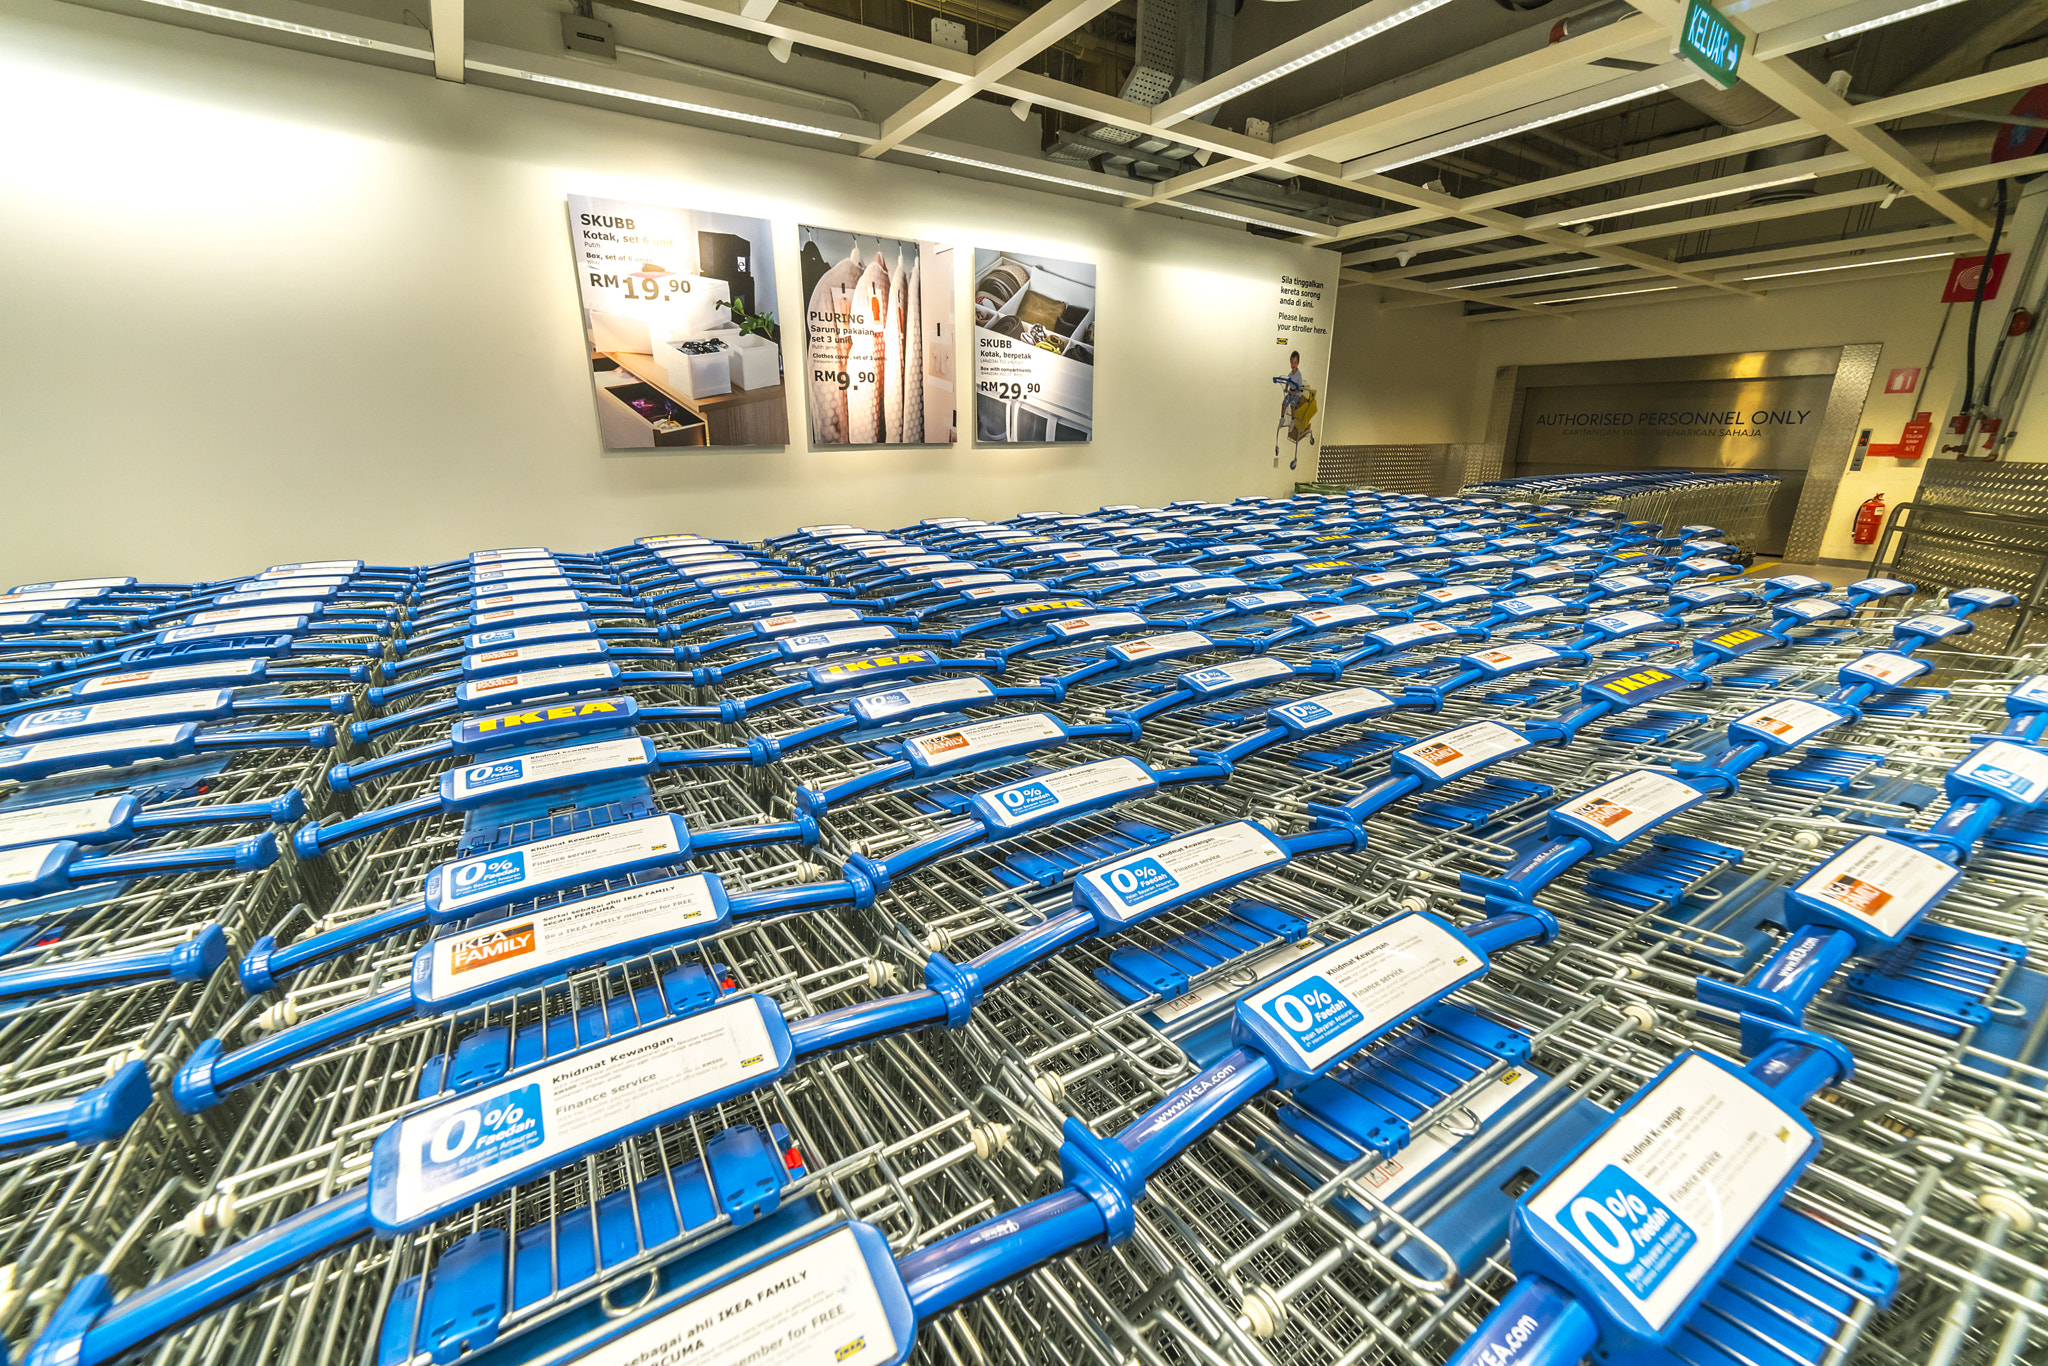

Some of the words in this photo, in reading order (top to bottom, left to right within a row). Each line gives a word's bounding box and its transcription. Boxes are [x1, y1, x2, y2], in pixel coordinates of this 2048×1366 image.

[1688, 4, 1729, 67] KELUAR
[580, 214, 635, 230] SKUBB
[583, 230, 620, 244] Kotak,
[623, 235, 640, 244] set
[643, 236, 650, 245] 6
[653, 237, 674, 247] unit
[586, 252, 603, 260] Box,
[1281, 276, 1292, 284] Sila
[1294, 277, 1324, 289] tinggalkan
[1280, 286, 1300, 296] kereta
[1301, 290, 1320, 300] sorong
[1280, 298, 1294, 306] anda
[1302, 300, 1314, 308] sini.
[810, 311, 864, 324] PLURING
[1278, 312, 1298, 322] Please
[1298, 314, 1314, 324] leave
[810, 324, 840, 335] Sarung
[843, 327, 877, 336] pakaian,
[1278, 324, 1291, 332] your
[1292, 324, 1312, 333] stroller
[1314, 326, 1328, 334] here.
[835, 336, 852, 344] unit
[980, 338, 1012, 348] SKUBB
[980, 350, 1002, 358] Kotak,
[1004, 352, 1032, 360] berpetak
[1536, 412, 1634, 426] AUTHORISED
[1637, 411, 1744, 426] PERSONNEL
[1751, 410, 1812, 425] ONLY
[1718, 428, 1762, 438] SAHAJA
[1316, 534, 1352, 542] IKEA
[1304, 560, 1352, 569] IKEA
[1016, 600, 1086, 614] IKEA
[1712, 628, 1764, 648] IKEA
[827, 654, 926, 675] IKEA
[1603, 668, 1672, 695] IKEA
[479, 701, 618, 732] IKEA
[920, 736, 950, 746] IKEA
[926, 737, 964, 752] FAMILY
[1424, 748, 1457, 763] FAMILY
[470, 764, 514, 782] 0%
[1002, 788, 1042, 808] 0%
[530, 840, 566, 852] Khidmat
[568, 831, 610, 844] Kewangan
[532, 854, 565, 867] Finance
[568, 848, 598, 859] service
[1158, 846, 1184, 858] Khidmat
[1199, 854, 1221, 865] service
[456, 860, 513, 886] 0%
[483, 867, 520, 881] Faedah
[1110, 866, 1156, 894] 0%
[1140, 873, 1168, 888] Faedah
[542, 912, 569, 922] Sertai
[570, 904, 604, 916] sebagai
[622, 892, 644, 902] IKEA
[645, 886, 675, 896] FAMILY
[543, 917, 572, 927] secara
[574, 906, 616, 919] PERCUMA
[566, 924, 588, 934] IKEA
[590, 916, 622, 928] FAMILY
[624, 907, 657, 919] member
[672, 898, 692, 907] FREE
[453, 930, 508, 954] IKEA
[454, 934, 532, 967] FAMILY
[1326, 958, 1356, 977] Khidmat
[1778, 937, 1820, 978] www.IKEA.com
[1352, 981, 1380, 999] Finance
[1380, 968, 1404, 984] service
[1274, 989, 1332, 1032] 0%
[1314, 1000, 1348, 1022] Faedah
[1300, 1031, 1316, 1042] Pelan
[1314, 1020, 1336, 1034] Bayaran
[552, 1059, 606, 1084] Khidmat
[610, 1036, 674, 1063] Kewangan
[556, 1091, 608, 1116] Finance
[611, 1073, 657, 1095] service
[1154, 1064, 1236, 1124] www.IKEA.com
[430, 1102, 524, 1164] 0%
[475, 1117, 536, 1150] Faedah
[1620, 1135, 1653, 1165] Khidmat
[1570, 1188, 1648, 1266] 0%
[1630, 1206, 1670, 1248] Faedah
[688, 1316, 714, 1338] ahli
[718, 1298, 752, 1323] IKEA
[757, 1270, 808, 1302] FAMILY
[787, 1324, 810, 1342] for
[812, 1303, 845, 1330] FREE
